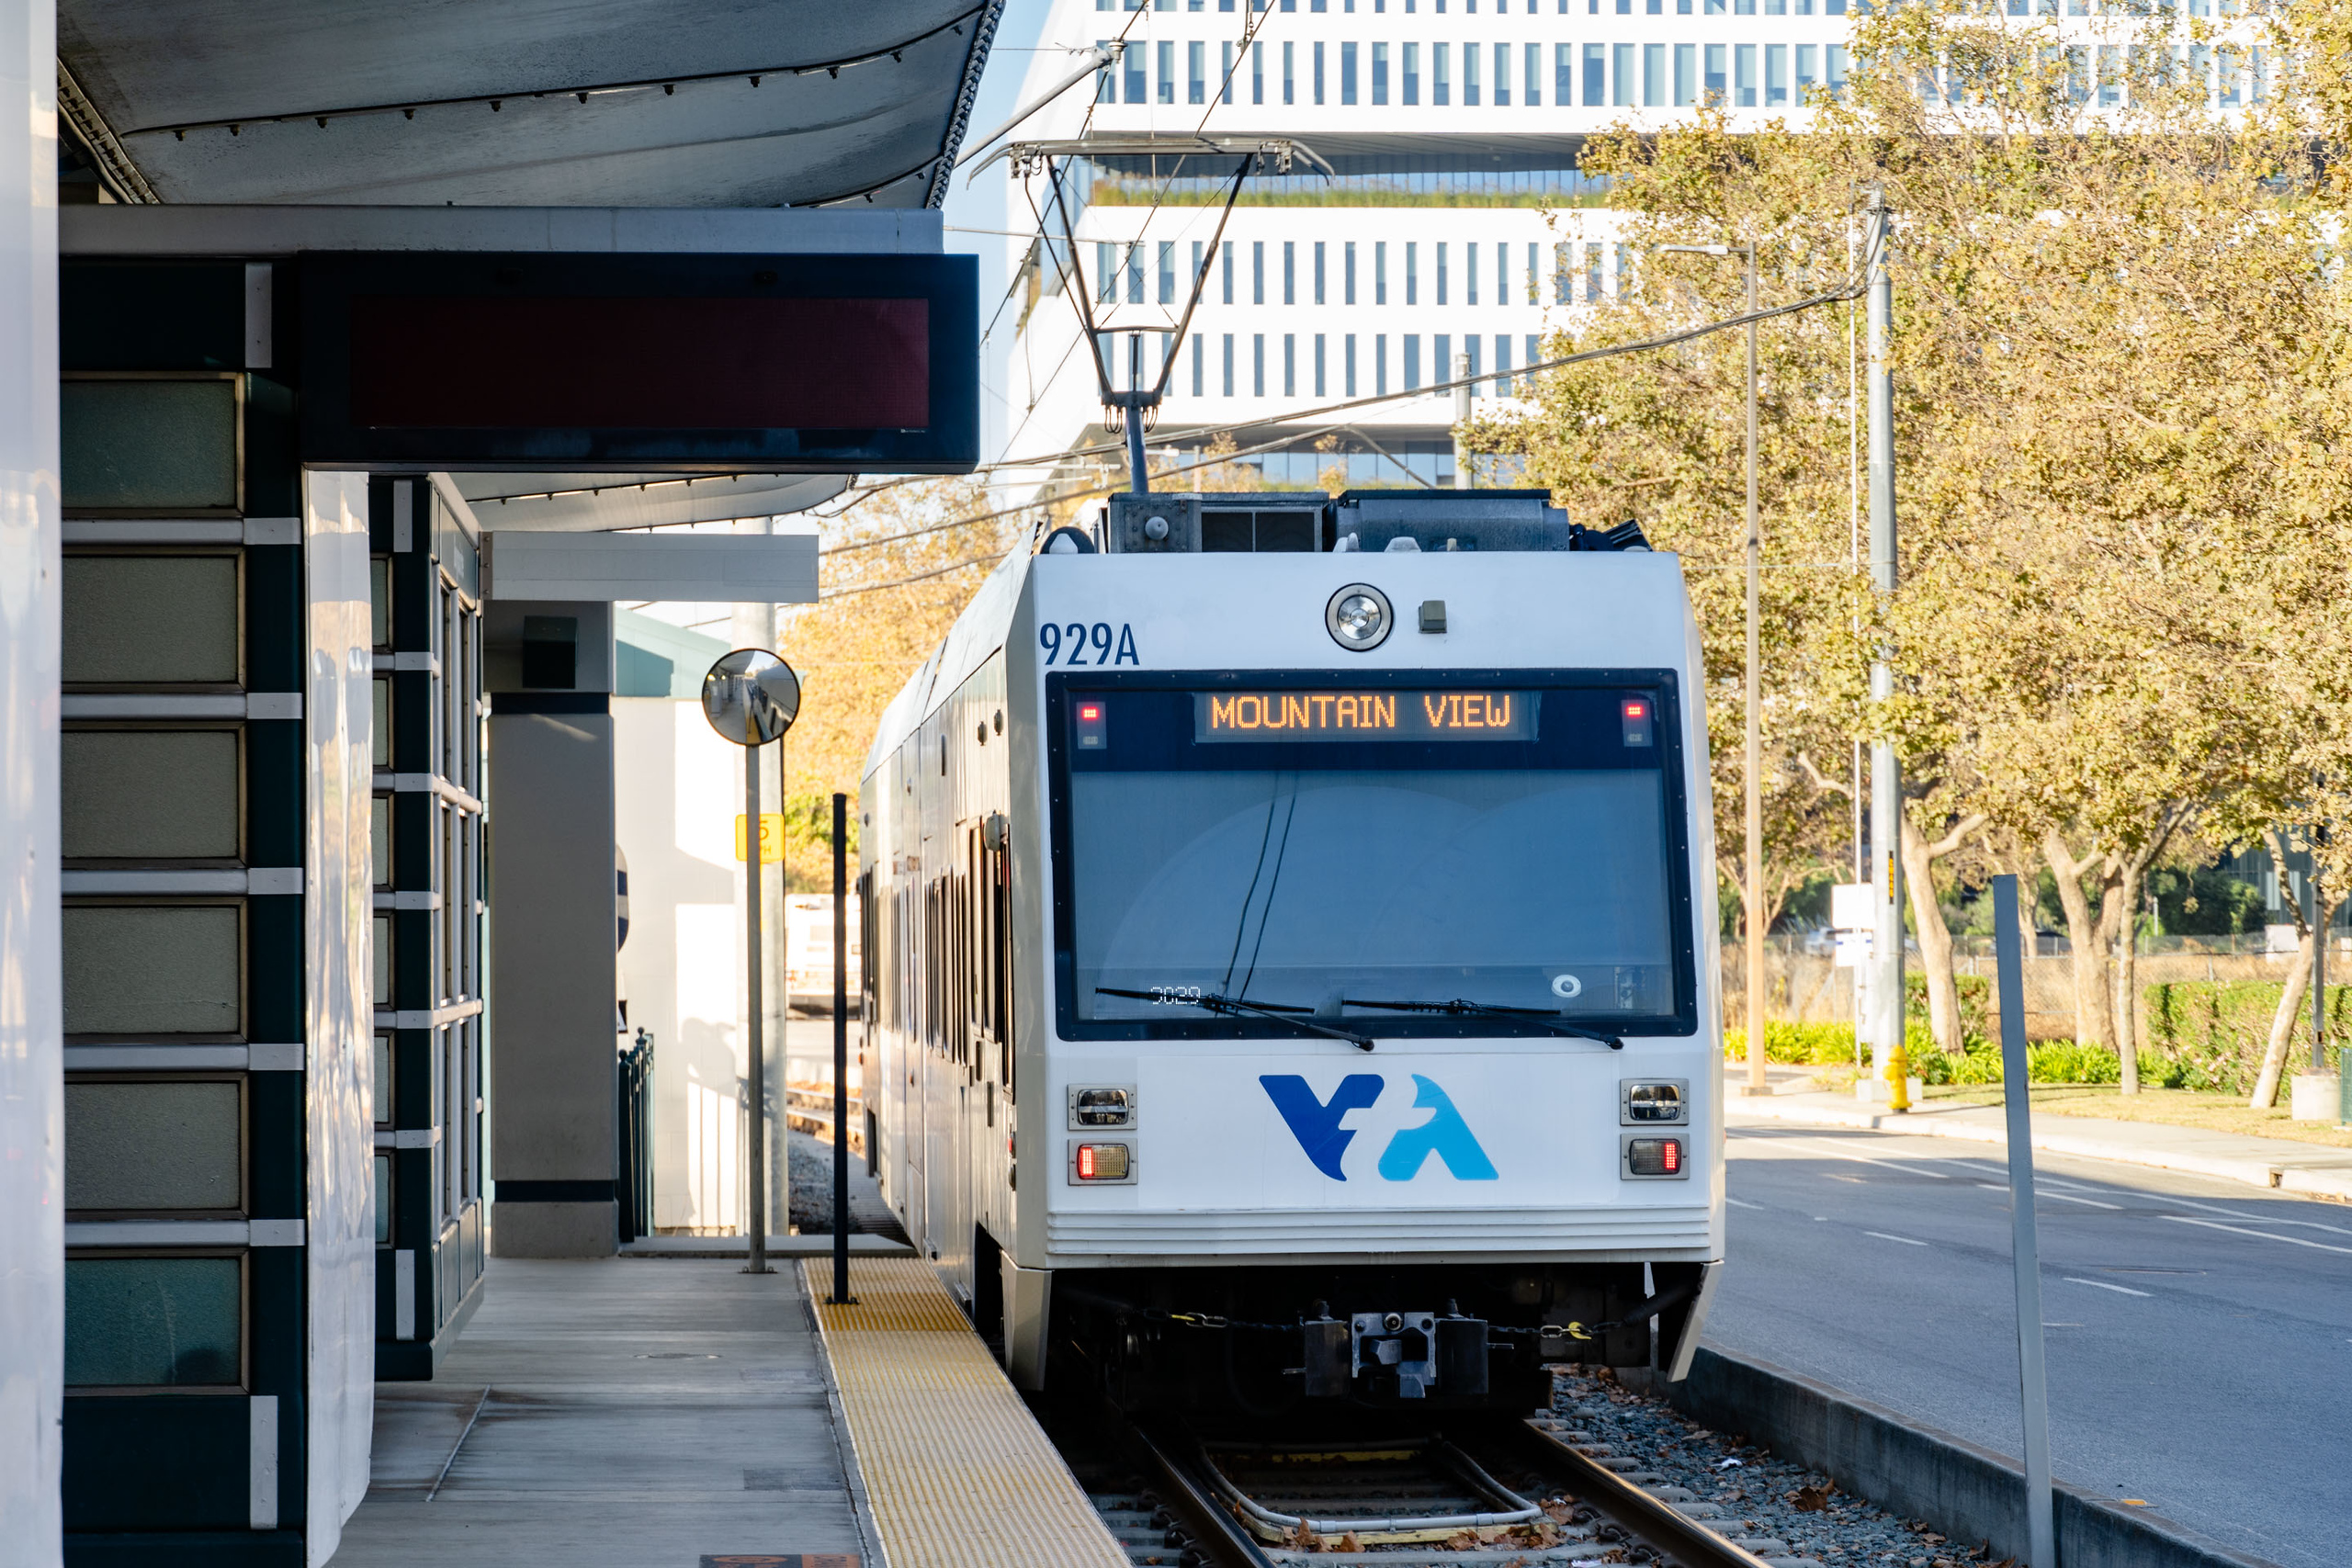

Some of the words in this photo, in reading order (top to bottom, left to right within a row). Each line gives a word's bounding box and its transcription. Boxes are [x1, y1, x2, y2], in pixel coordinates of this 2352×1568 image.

[1039, 622, 1140, 666] 929A
[1211, 694, 1396, 728] MOUNTAIN
[1423, 694, 1511, 728] VIEW
